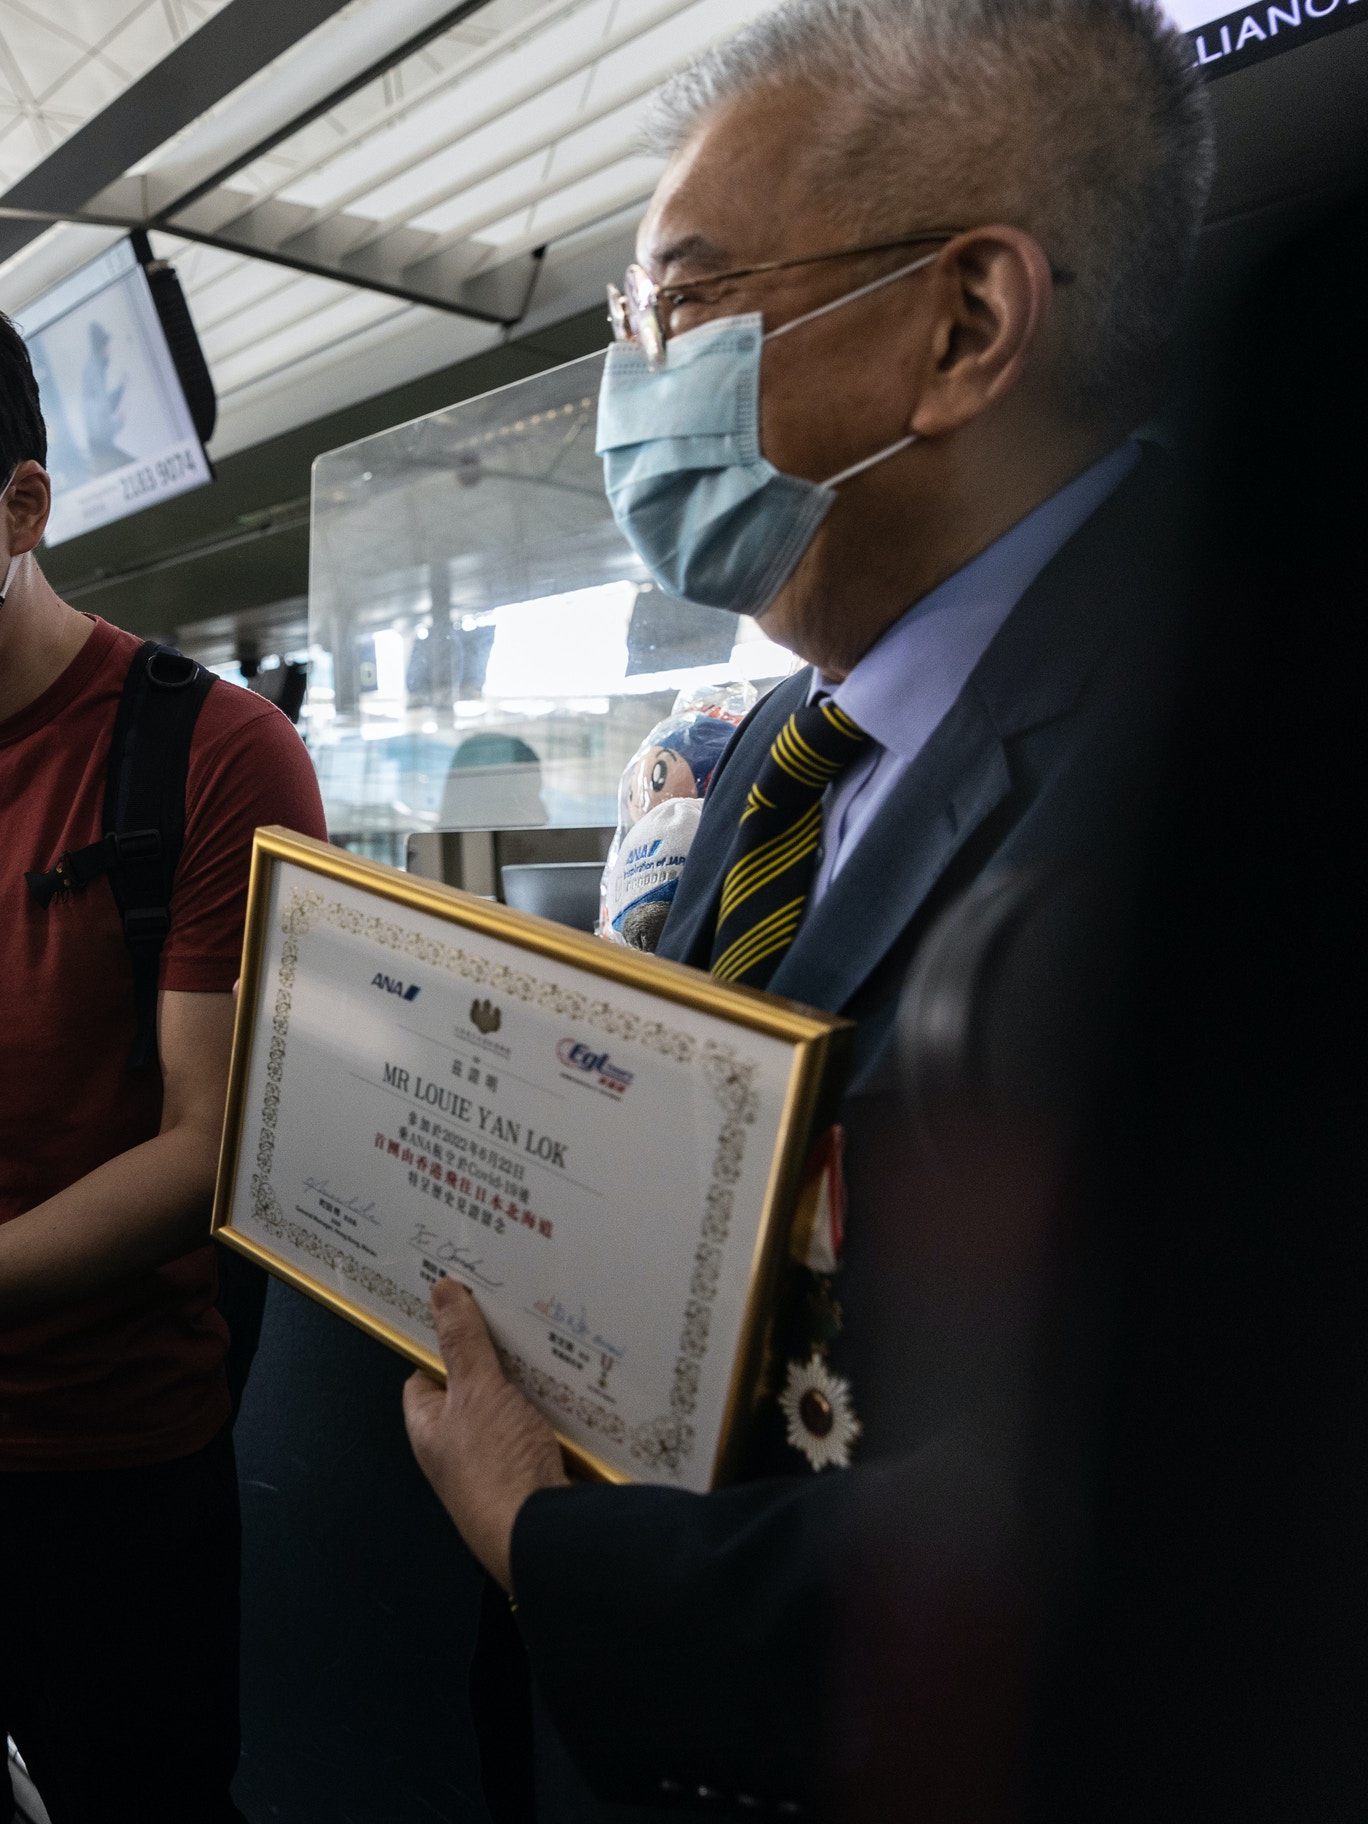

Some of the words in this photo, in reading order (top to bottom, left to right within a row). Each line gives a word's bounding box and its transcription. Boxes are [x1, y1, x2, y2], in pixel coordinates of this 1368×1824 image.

[1192, 0, 1362, 67] LIANC
[626, 844, 648, 865] ANA
[656, 857, 666, 867] of
[666, 856, 687, 867] JAP
[371, 973, 403, 998] ANA
[382, 1062, 410, 1092] MR
[414, 1077, 473, 1122] LOUIE
[478, 1106, 521, 1144] YAN
[524, 1129, 569, 1169] LOK
